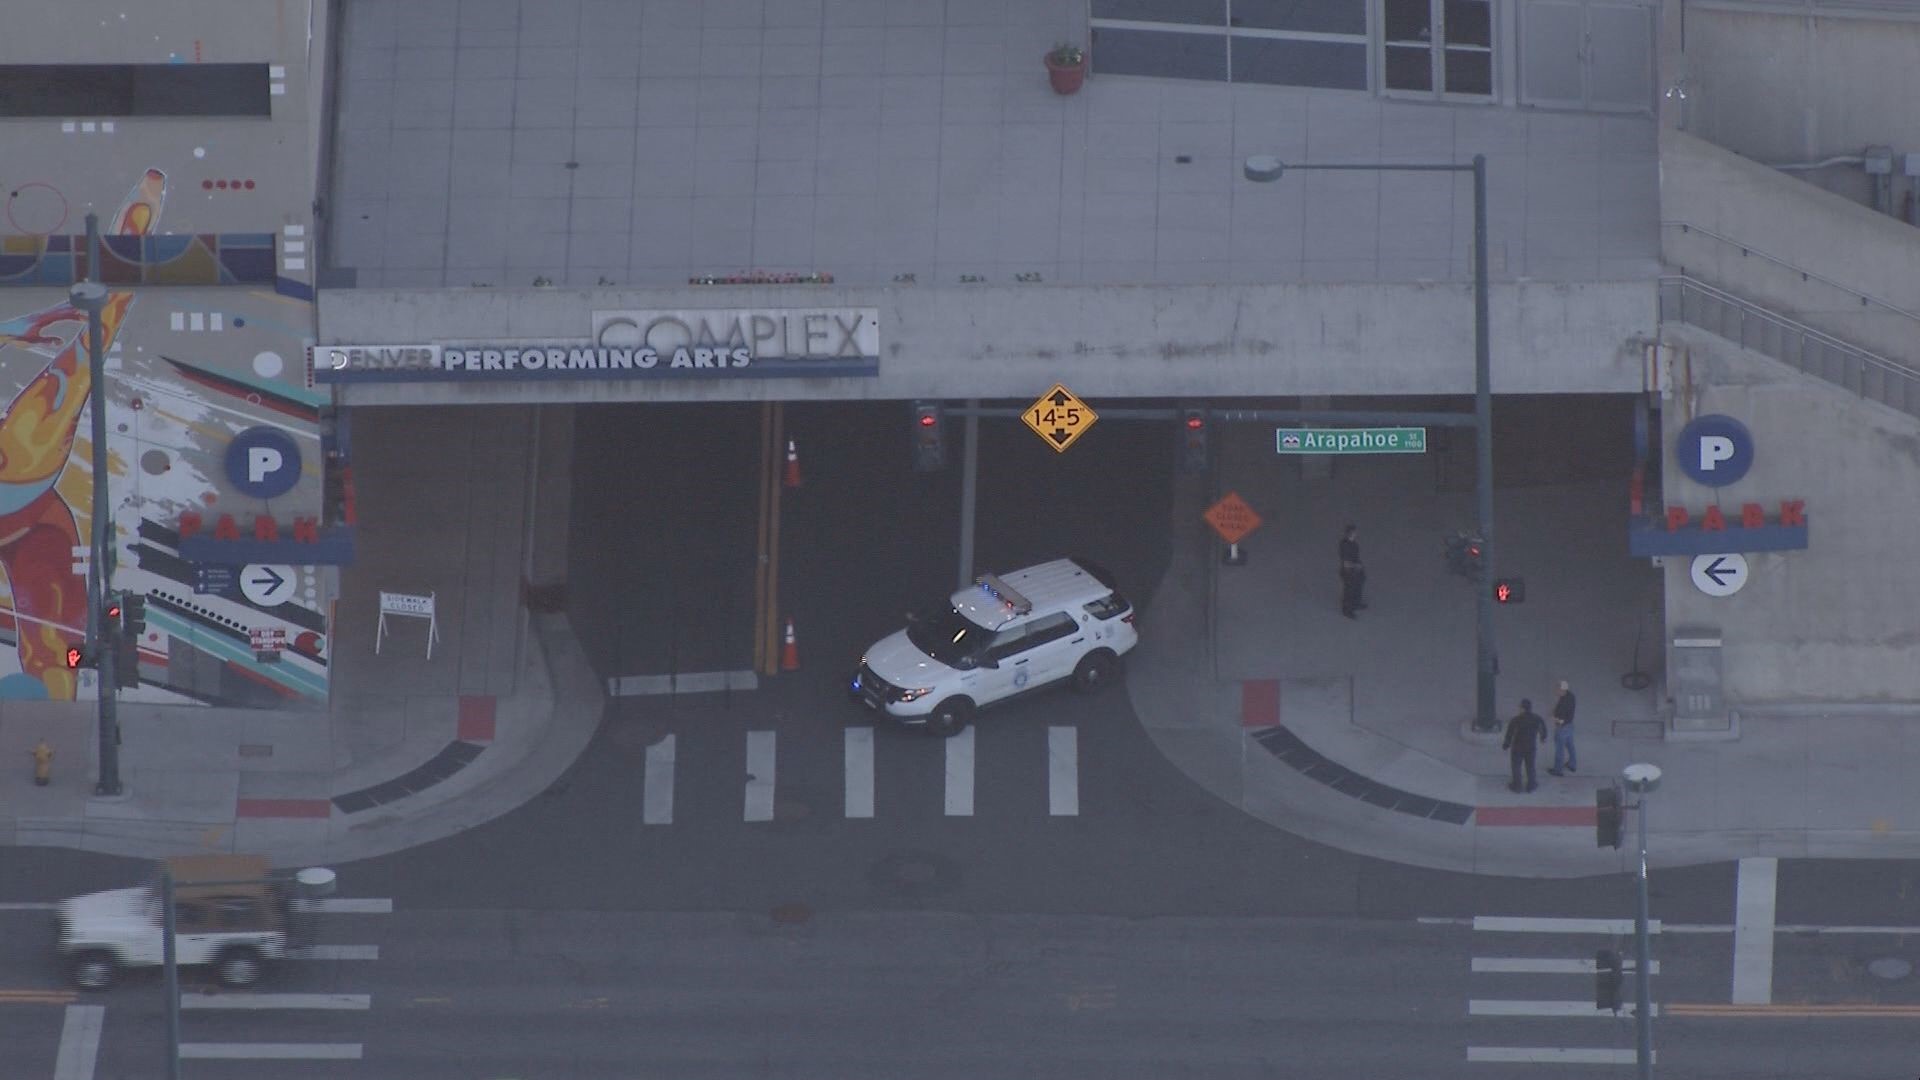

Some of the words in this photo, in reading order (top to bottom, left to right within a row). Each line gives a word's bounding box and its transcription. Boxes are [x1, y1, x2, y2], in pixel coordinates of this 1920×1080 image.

[599, 315, 865, 360] COMPLEX
[331, 349, 433, 370] DENVER
[445, 348, 659, 371] PERFORMING
[670, 347, 751, 369] ARTS
[1304, 431, 1399, 451] Arapahoe
[1700, 435, 1735, 471] P
[248, 447, 283, 483] P
[179, 511, 320, 544] PARK
[1667, 500, 1806, 535] PARK
